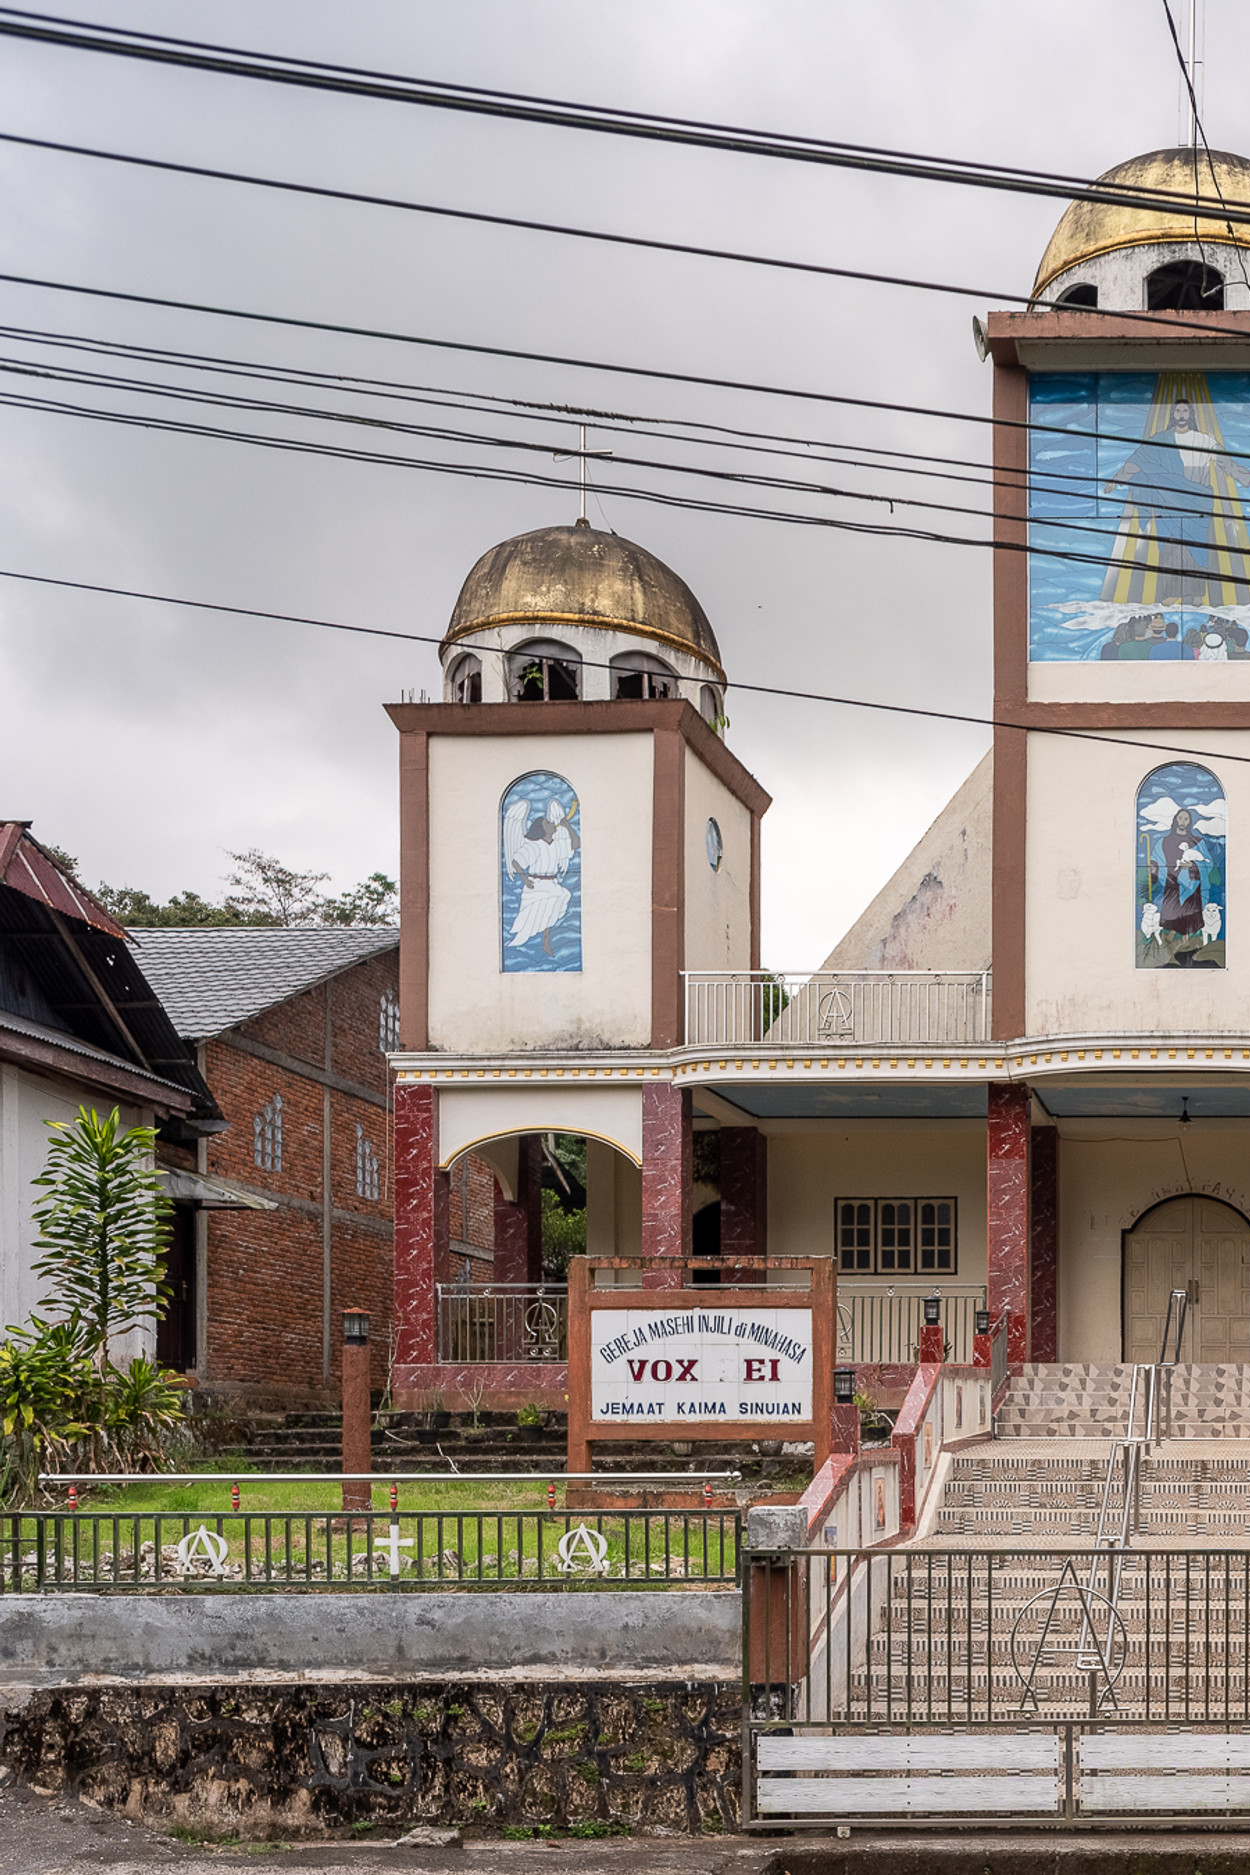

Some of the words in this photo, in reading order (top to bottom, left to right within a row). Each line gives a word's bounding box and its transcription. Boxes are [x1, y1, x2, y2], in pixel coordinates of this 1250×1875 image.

[599, 1326, 649, 1364] GEREJA
[648, 1315, 695, 1341] MASEHI
[698, 1314, 734, 1336] INJILI
[734, 1321, 748, 1339] di
[747, 1322, 808, 1364] MINAHASA
[627, 1358, 699, 1382] VOX
[600, 1402, 665, 1416] JEMAAT
[677, 1402, 727, 1416] KAIMA
[739, 1402, 802, 1416] SINUIAN
